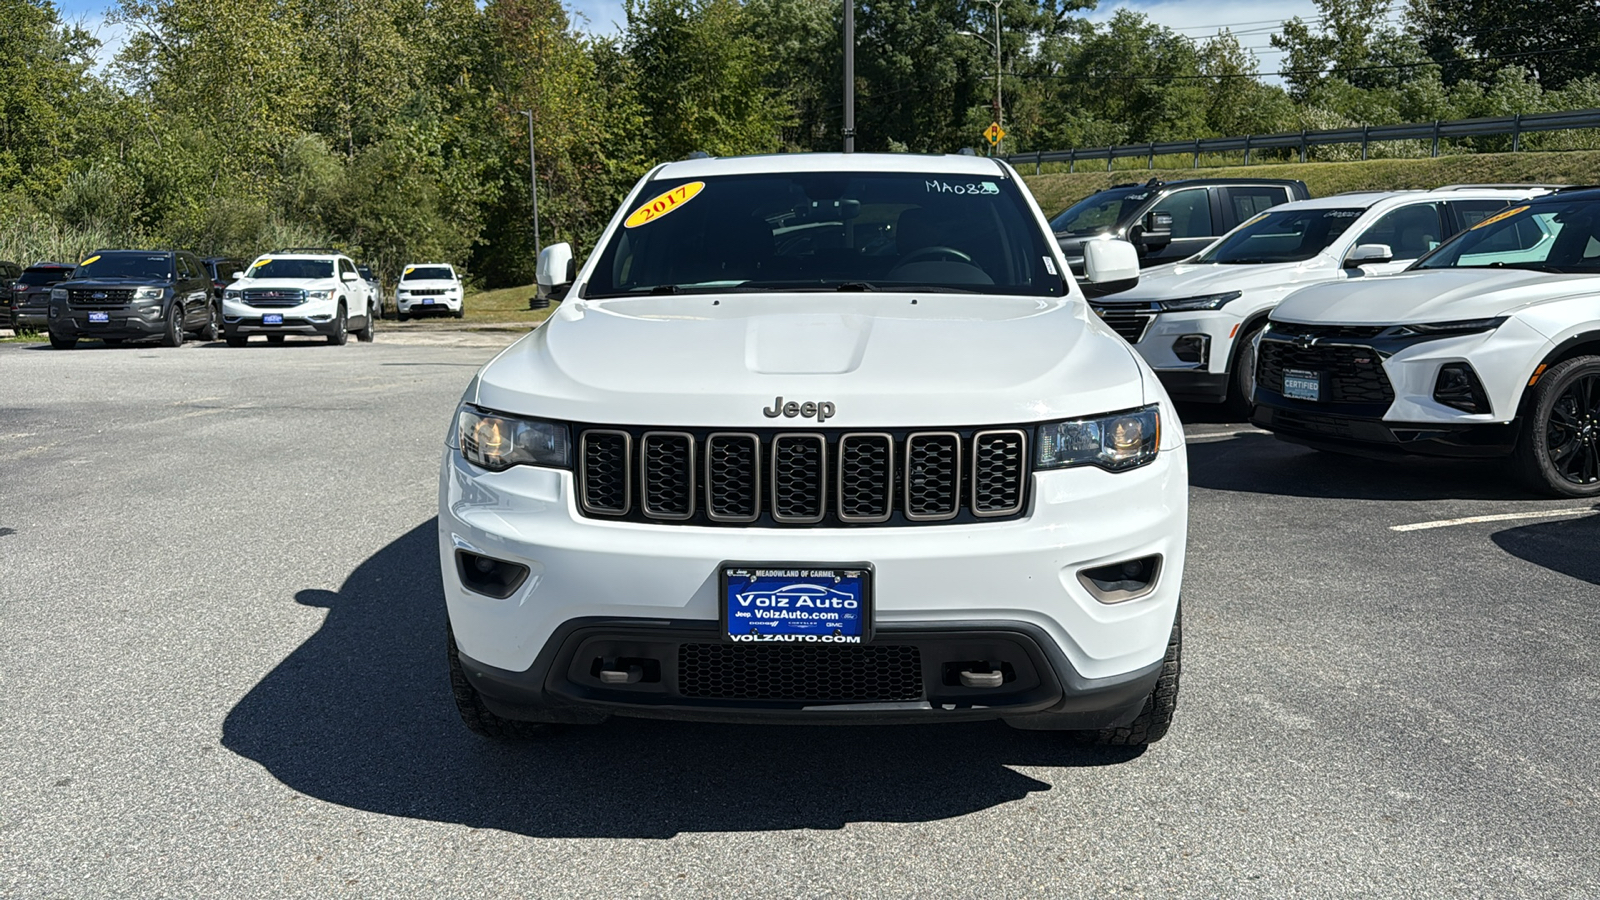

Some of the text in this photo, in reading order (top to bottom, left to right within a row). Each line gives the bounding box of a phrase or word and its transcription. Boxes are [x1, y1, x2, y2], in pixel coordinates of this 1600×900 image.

[640, 187, 686, 221] 2017
[1284, 379, 1319, 391] CERTIFIED
[763, 396, 836, 422] Jeep
[801, 570, 809, 578] OF
[735, 594, 858, 609] Volz Auto
[754, 609, 839, 620] VolzAuto.com
[730, 634, 861, 643] VOLZAUTO.COM
